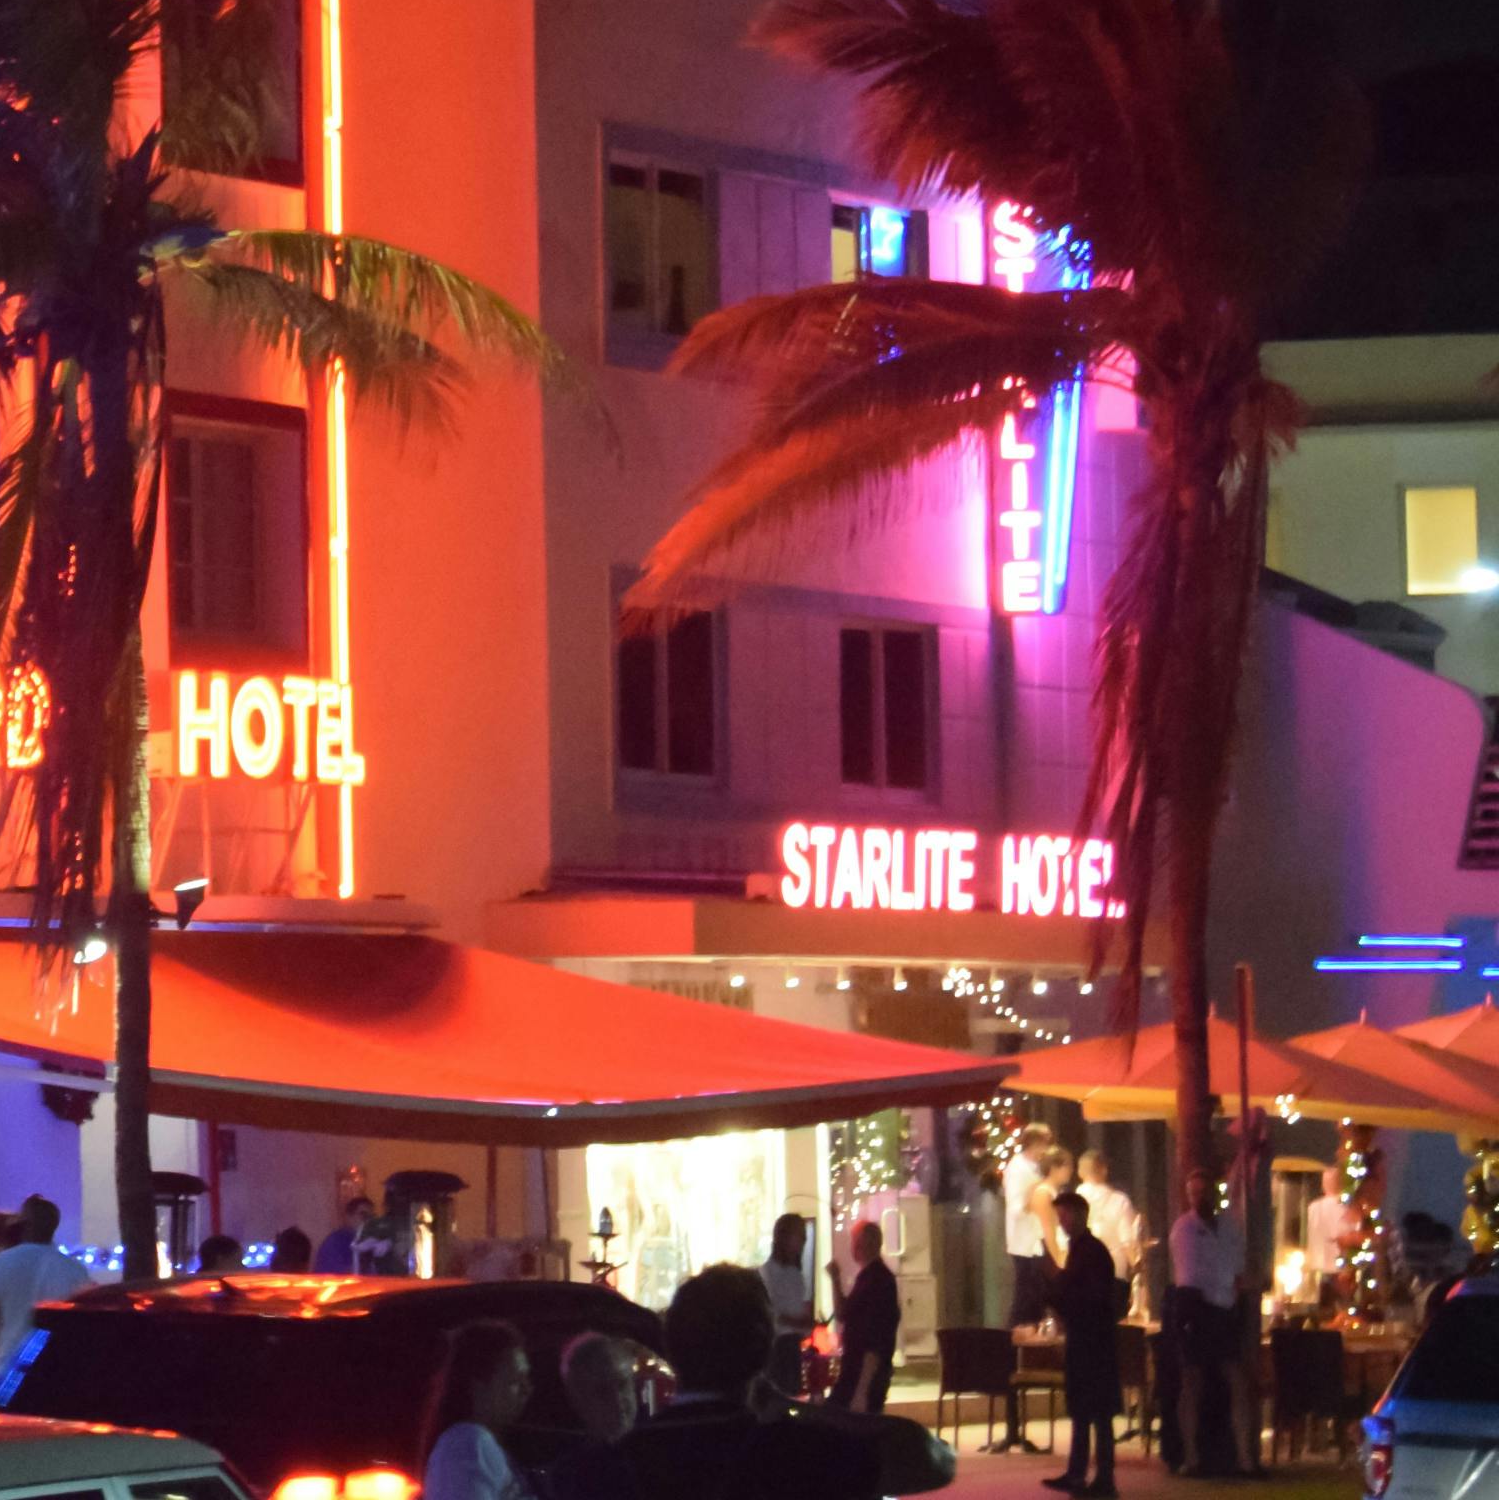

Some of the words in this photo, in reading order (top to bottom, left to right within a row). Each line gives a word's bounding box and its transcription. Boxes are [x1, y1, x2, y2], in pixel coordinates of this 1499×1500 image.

[992, 201, 1042, 613] STLITE
[177, 671, 366, 786] HOTEL
[780, 822, 978, 912] STARLITE
